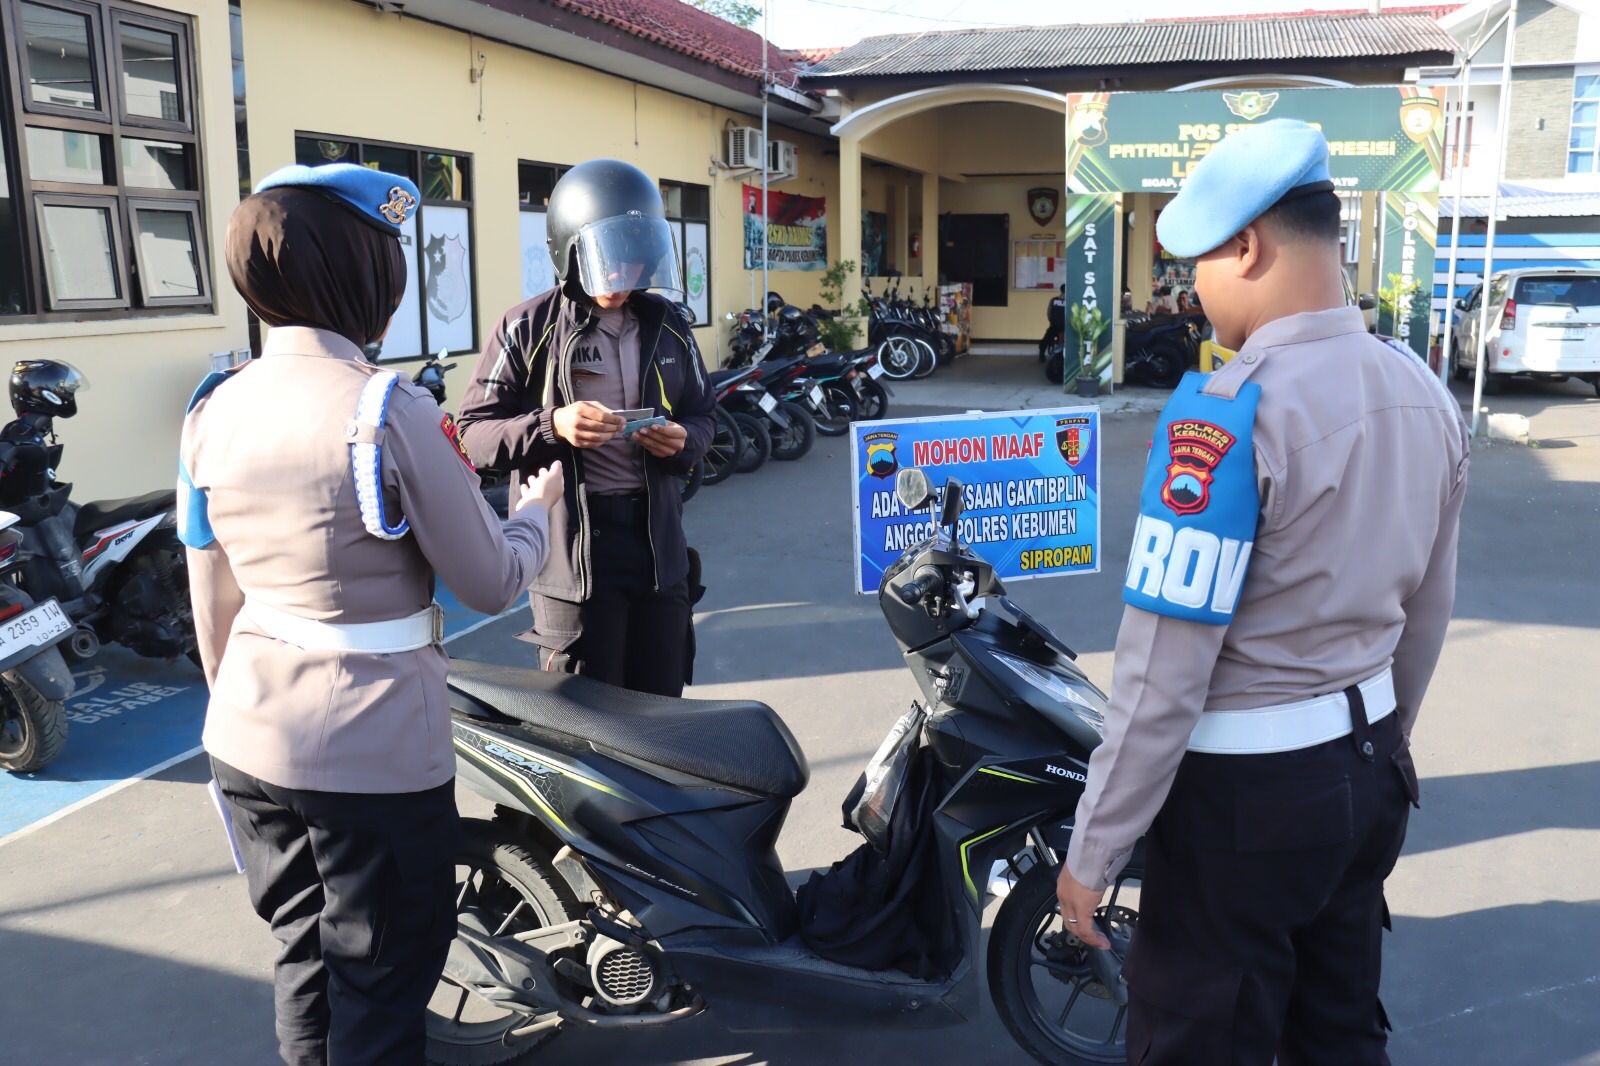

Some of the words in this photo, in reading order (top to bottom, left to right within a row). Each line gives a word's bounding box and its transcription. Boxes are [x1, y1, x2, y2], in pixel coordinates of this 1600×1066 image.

[1179, 124, 1221, 141] POS
[1109, 143, 1190, 159] PATROLI
[1327, 140, 1397, 156] RESISI
[1083, 223, 1098, 264] SAT
[1173, 423, 1230, 444] POLRES
[1174, 430, 1225, 449] KEBUMEN
[913, 437, 987, 467] MOHON
[992, 432, 1045, 460] MAAF
[1174, 445, 1191, 454] JAWA
[1191, 446, 1216, 463] TENGAH
[871, 491, 900, 519] ADA
[1006, 474, 1087, 508] GAKTIBPLIN
[957, 515, 1009, 545] POLRES
[1012, 508, 1077, 540] KEBUMEN
[1020, 544, 1093, 571] SIPROPAM
[8, 615, 40, 640] 2359
[43, 603, 61, 621] IW
[72, 686, 192, 724] DIFABEL
[1044, 764, 1088, 783] HOND
